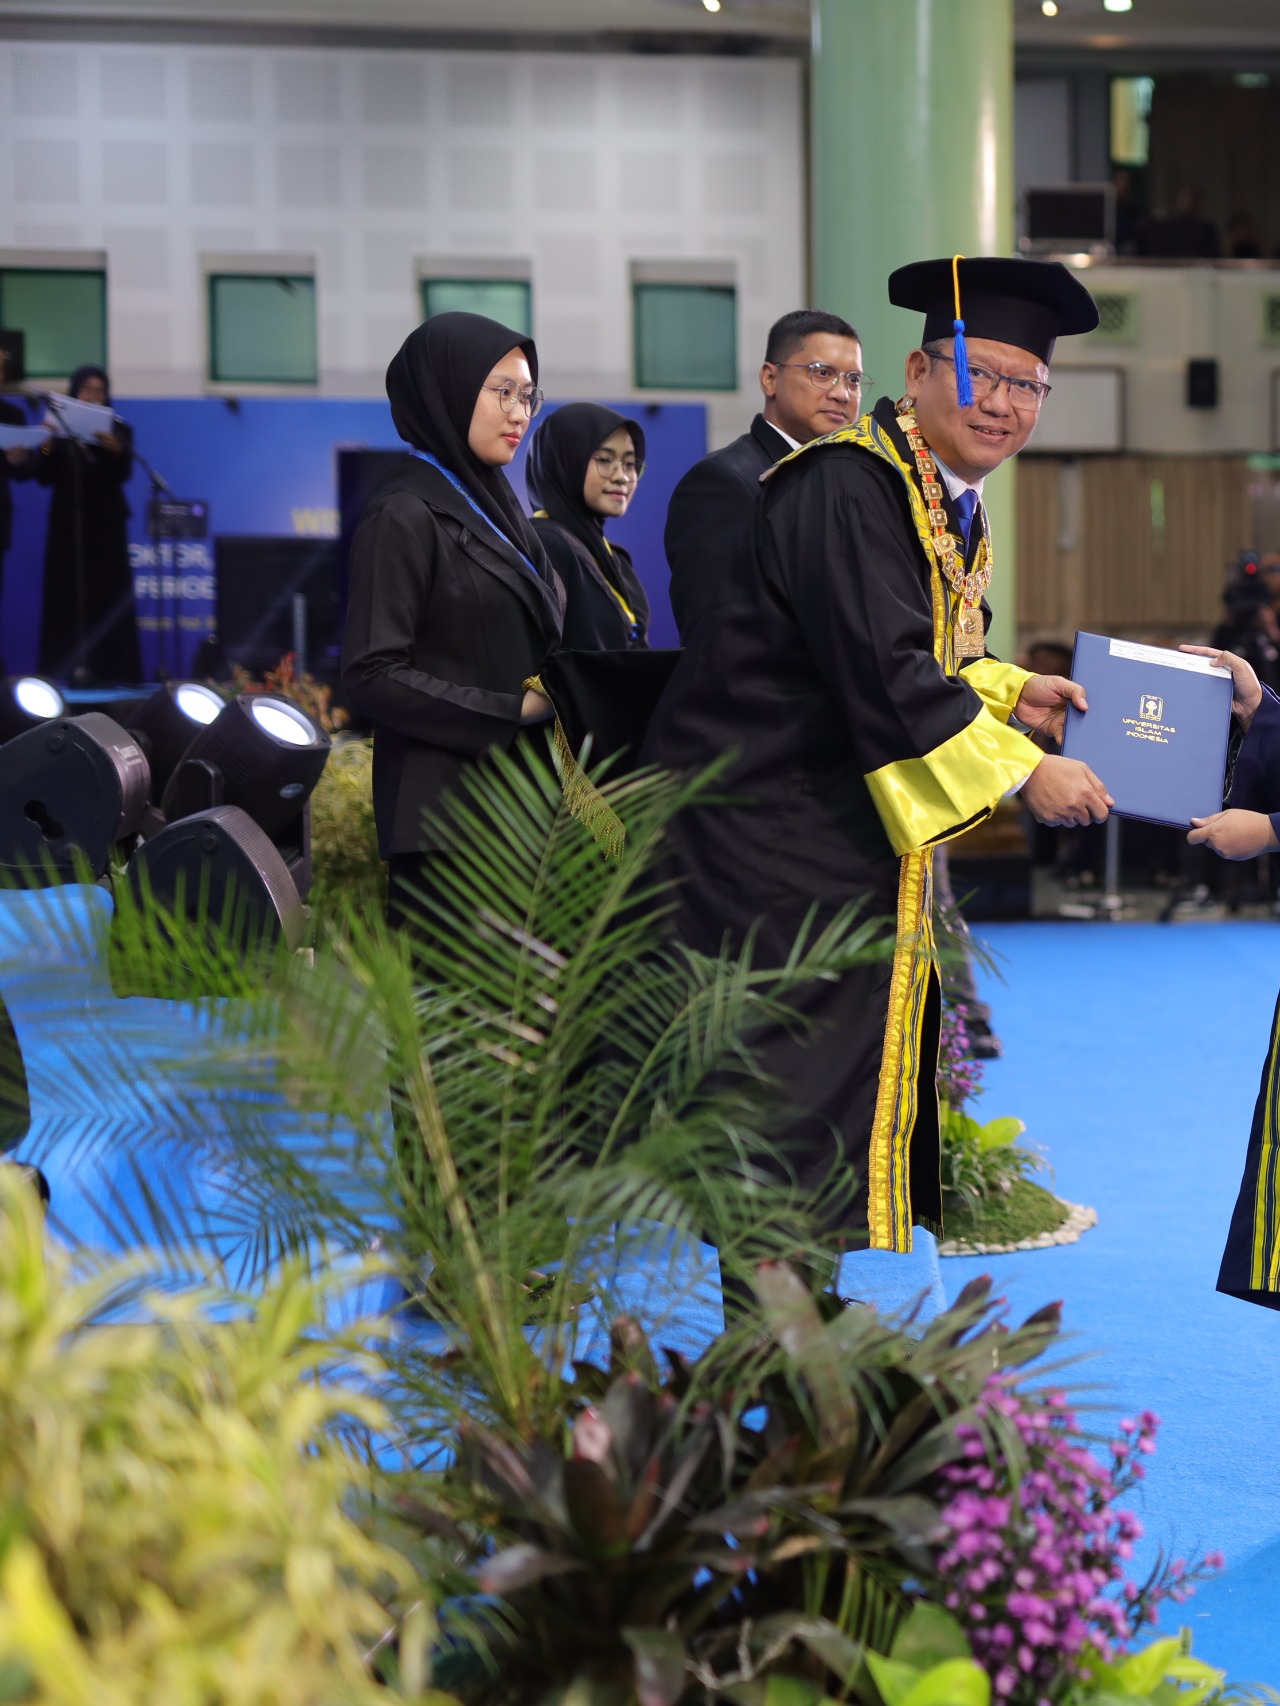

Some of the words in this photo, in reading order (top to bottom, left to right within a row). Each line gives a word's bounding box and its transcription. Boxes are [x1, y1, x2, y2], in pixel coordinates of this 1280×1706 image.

[1122, 718, 1175, 733] UNIVERSITAS
[1135, 726, 1161, 736] ISLAM
[1126, 731, 1168, 743] INDONESIA
